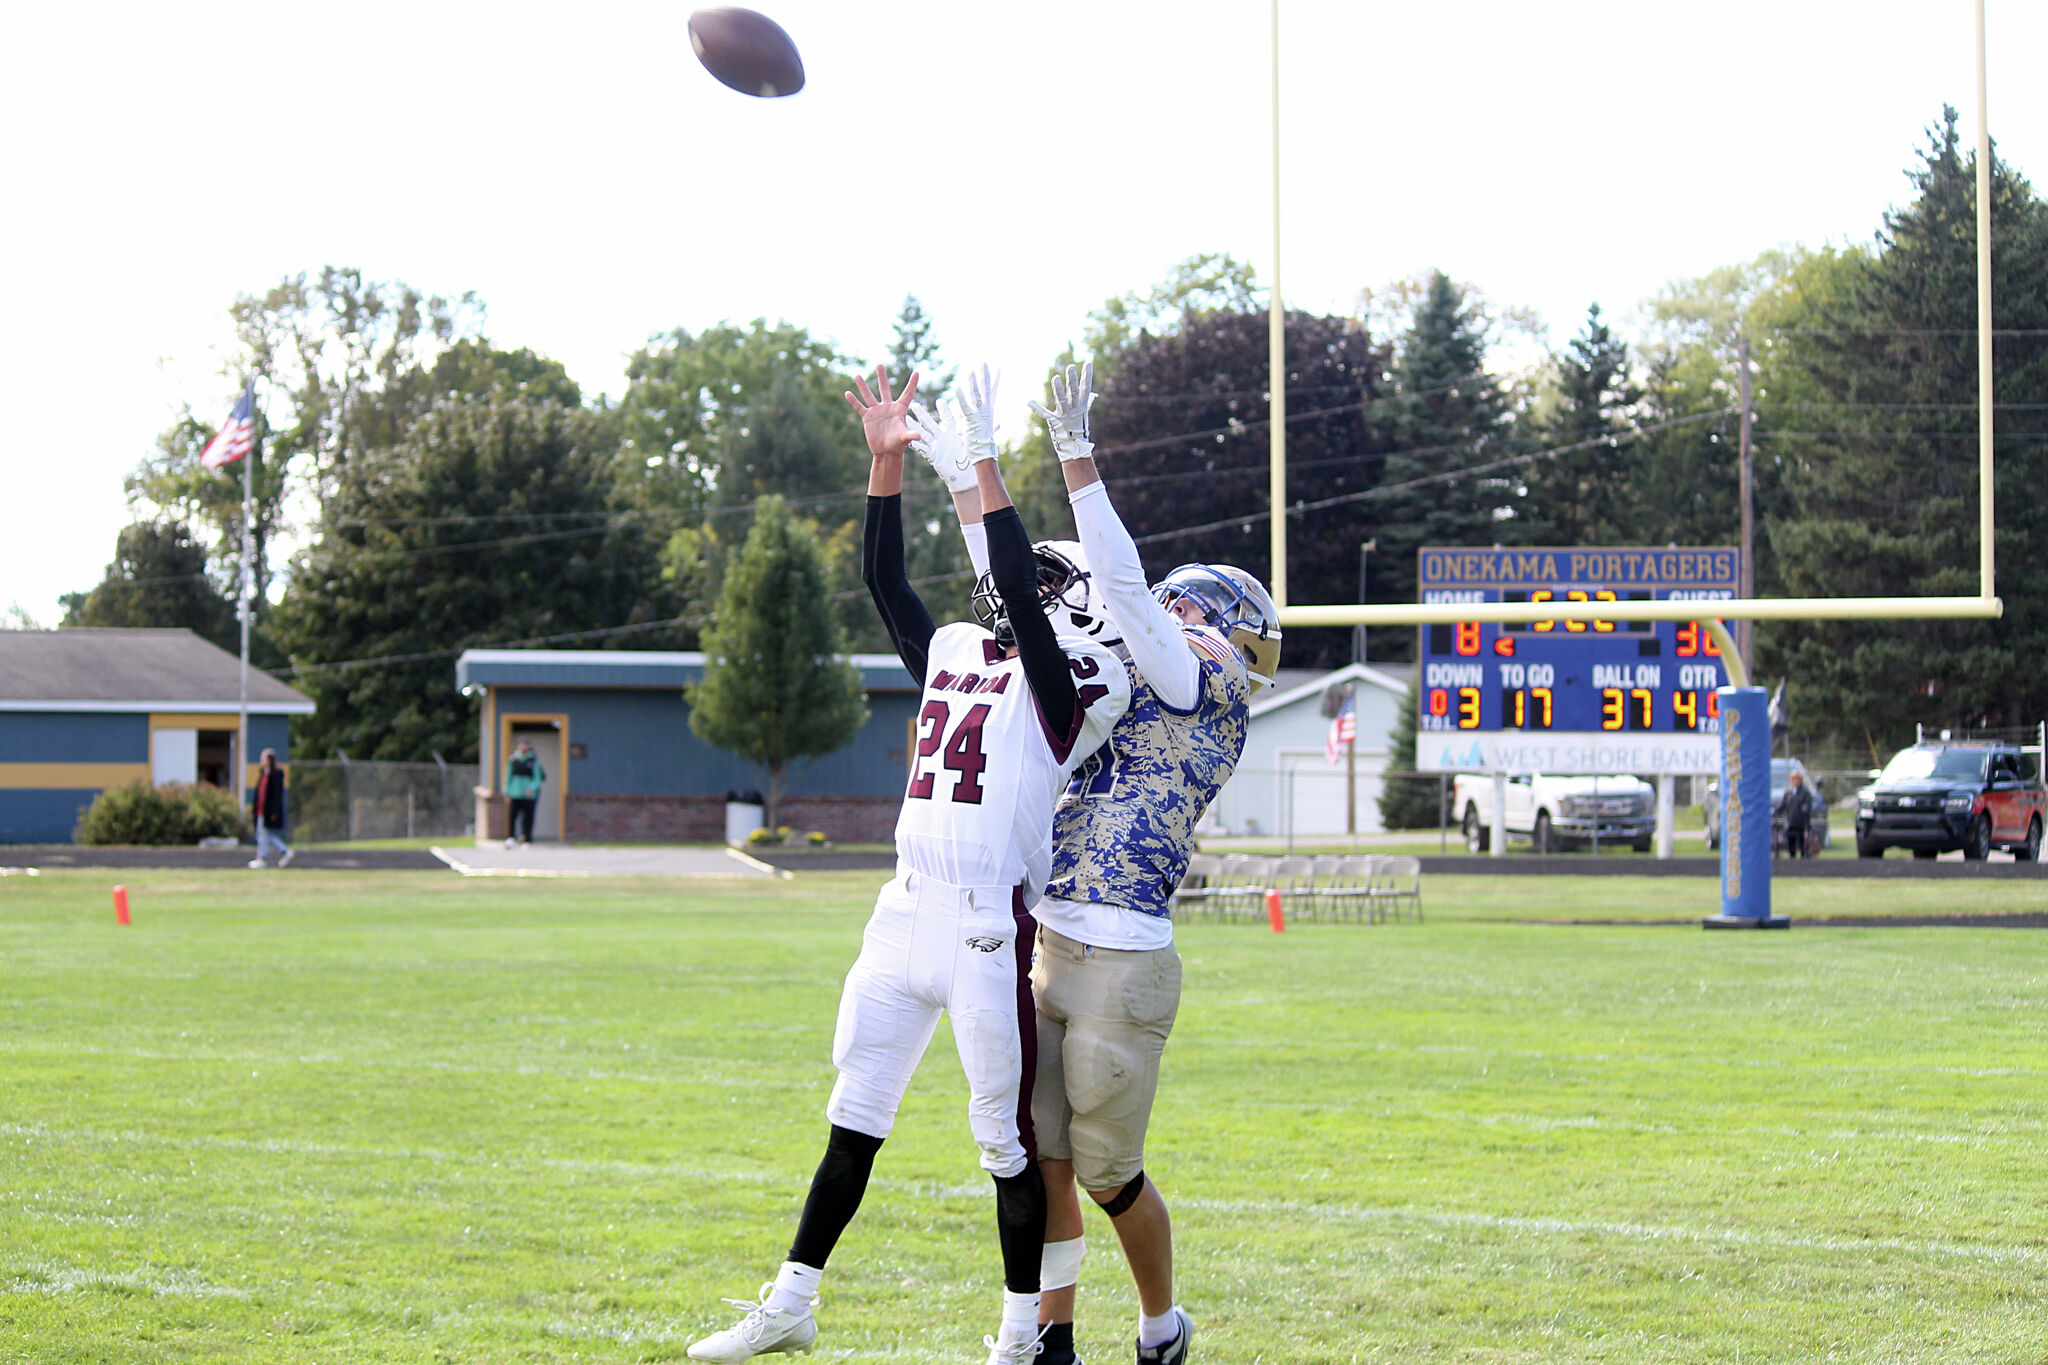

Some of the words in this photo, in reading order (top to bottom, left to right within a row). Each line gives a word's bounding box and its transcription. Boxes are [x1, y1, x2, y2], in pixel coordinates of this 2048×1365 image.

[1426, 555, 1558, 580] ONEKAMA
[1571, 555, 1731, 580] PORTAGERS
[1426, 663, 1483, 688] DOWN
[1499, 663, 1525, 688] TO
[1527, 663, 1554, 688] GO
[1592, 664, 1634, 688] BALL
[1636, 664, 1661, 688] ON
[1679, 665, 1717, 689] QTR
[1458, 687, 1481, 729] 3
[1515, 687, 1553, 728] 17
[1602, 688, 1653, 730] 37
[1672, 690, 1697, 728] 4
[908, 700, 992, 805] 24
[1496, 746, 1560, 767] WEST
[1567, 746, 1642, 769] SHORE
[1652, 746, 1716, 769] BANK
